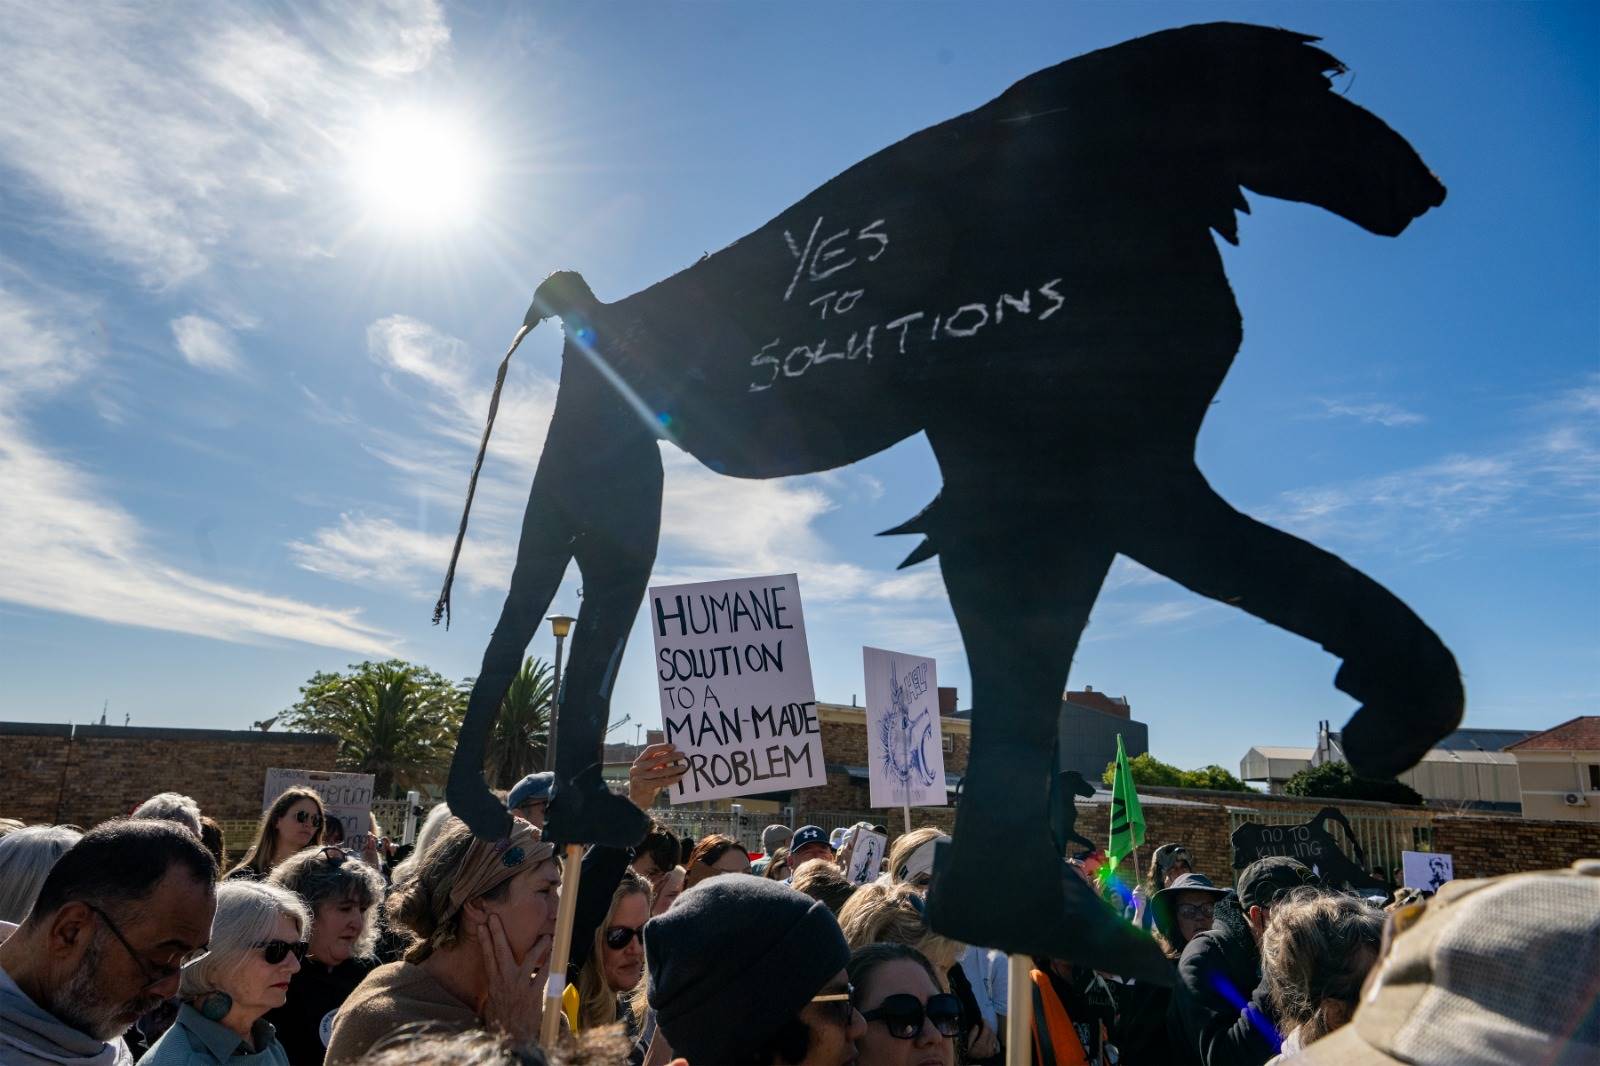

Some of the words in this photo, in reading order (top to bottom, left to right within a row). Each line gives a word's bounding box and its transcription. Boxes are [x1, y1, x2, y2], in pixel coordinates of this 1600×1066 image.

[783, 216, 889, 301] YES
[809, 288, 865, 320] TO
[748, 277, 1065, 392] SOLUTIONS
[654, 586, 794, 637] HUMANE
[659, 640, 784, 682] SOLUTION
[664, 686, 696, 710] TO
[703, 684, 721, 709] A
[666, 702, 820, 748] MAN-MADE
[671, 741, 813, 796] PROBLEM
[1288, 825, 1310, 842] TO
